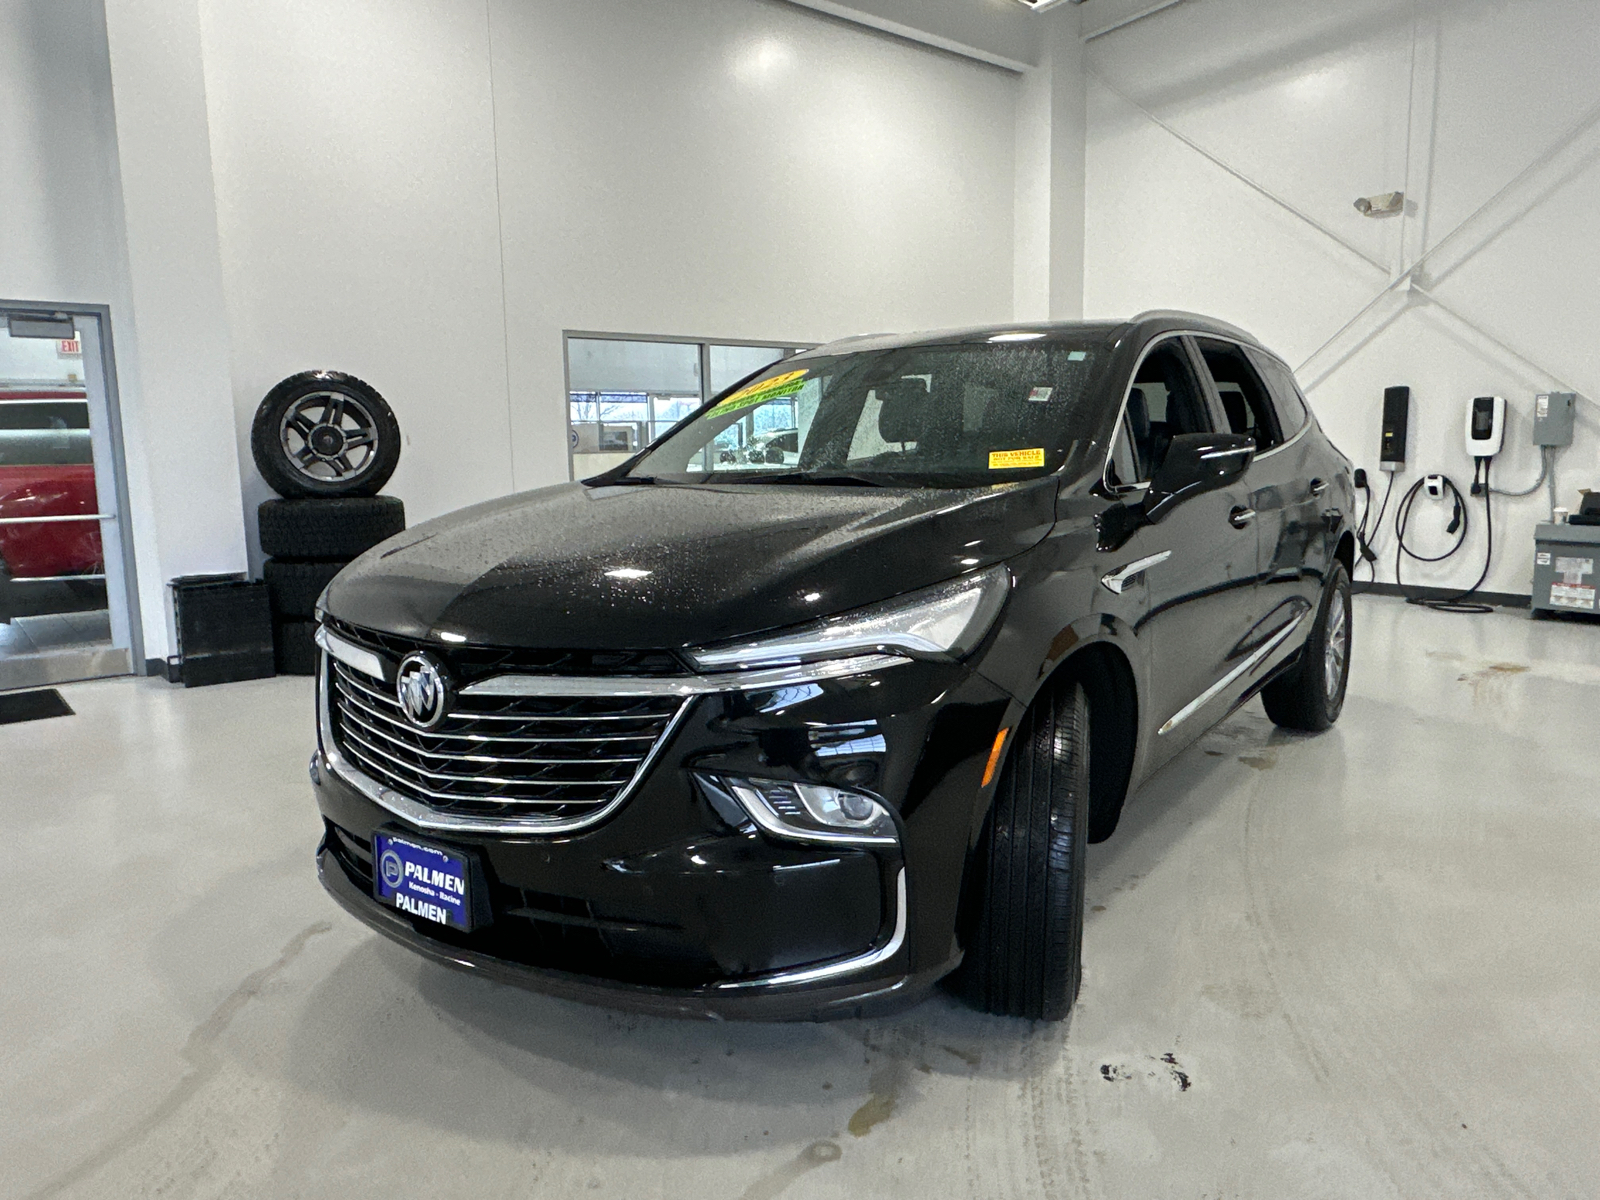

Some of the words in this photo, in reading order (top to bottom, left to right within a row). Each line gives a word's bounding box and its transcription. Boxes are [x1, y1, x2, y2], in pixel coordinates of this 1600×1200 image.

[61, 340, 79, 352] EXIT
[761, 384, 804, 399] MONITOR
[405, 861, 465, 895] PALMEN
[408, 881, 435, 897] Kenosha
[439, 891, 461, 906] Racine
[396, 892, 447, 925] PALMEN
